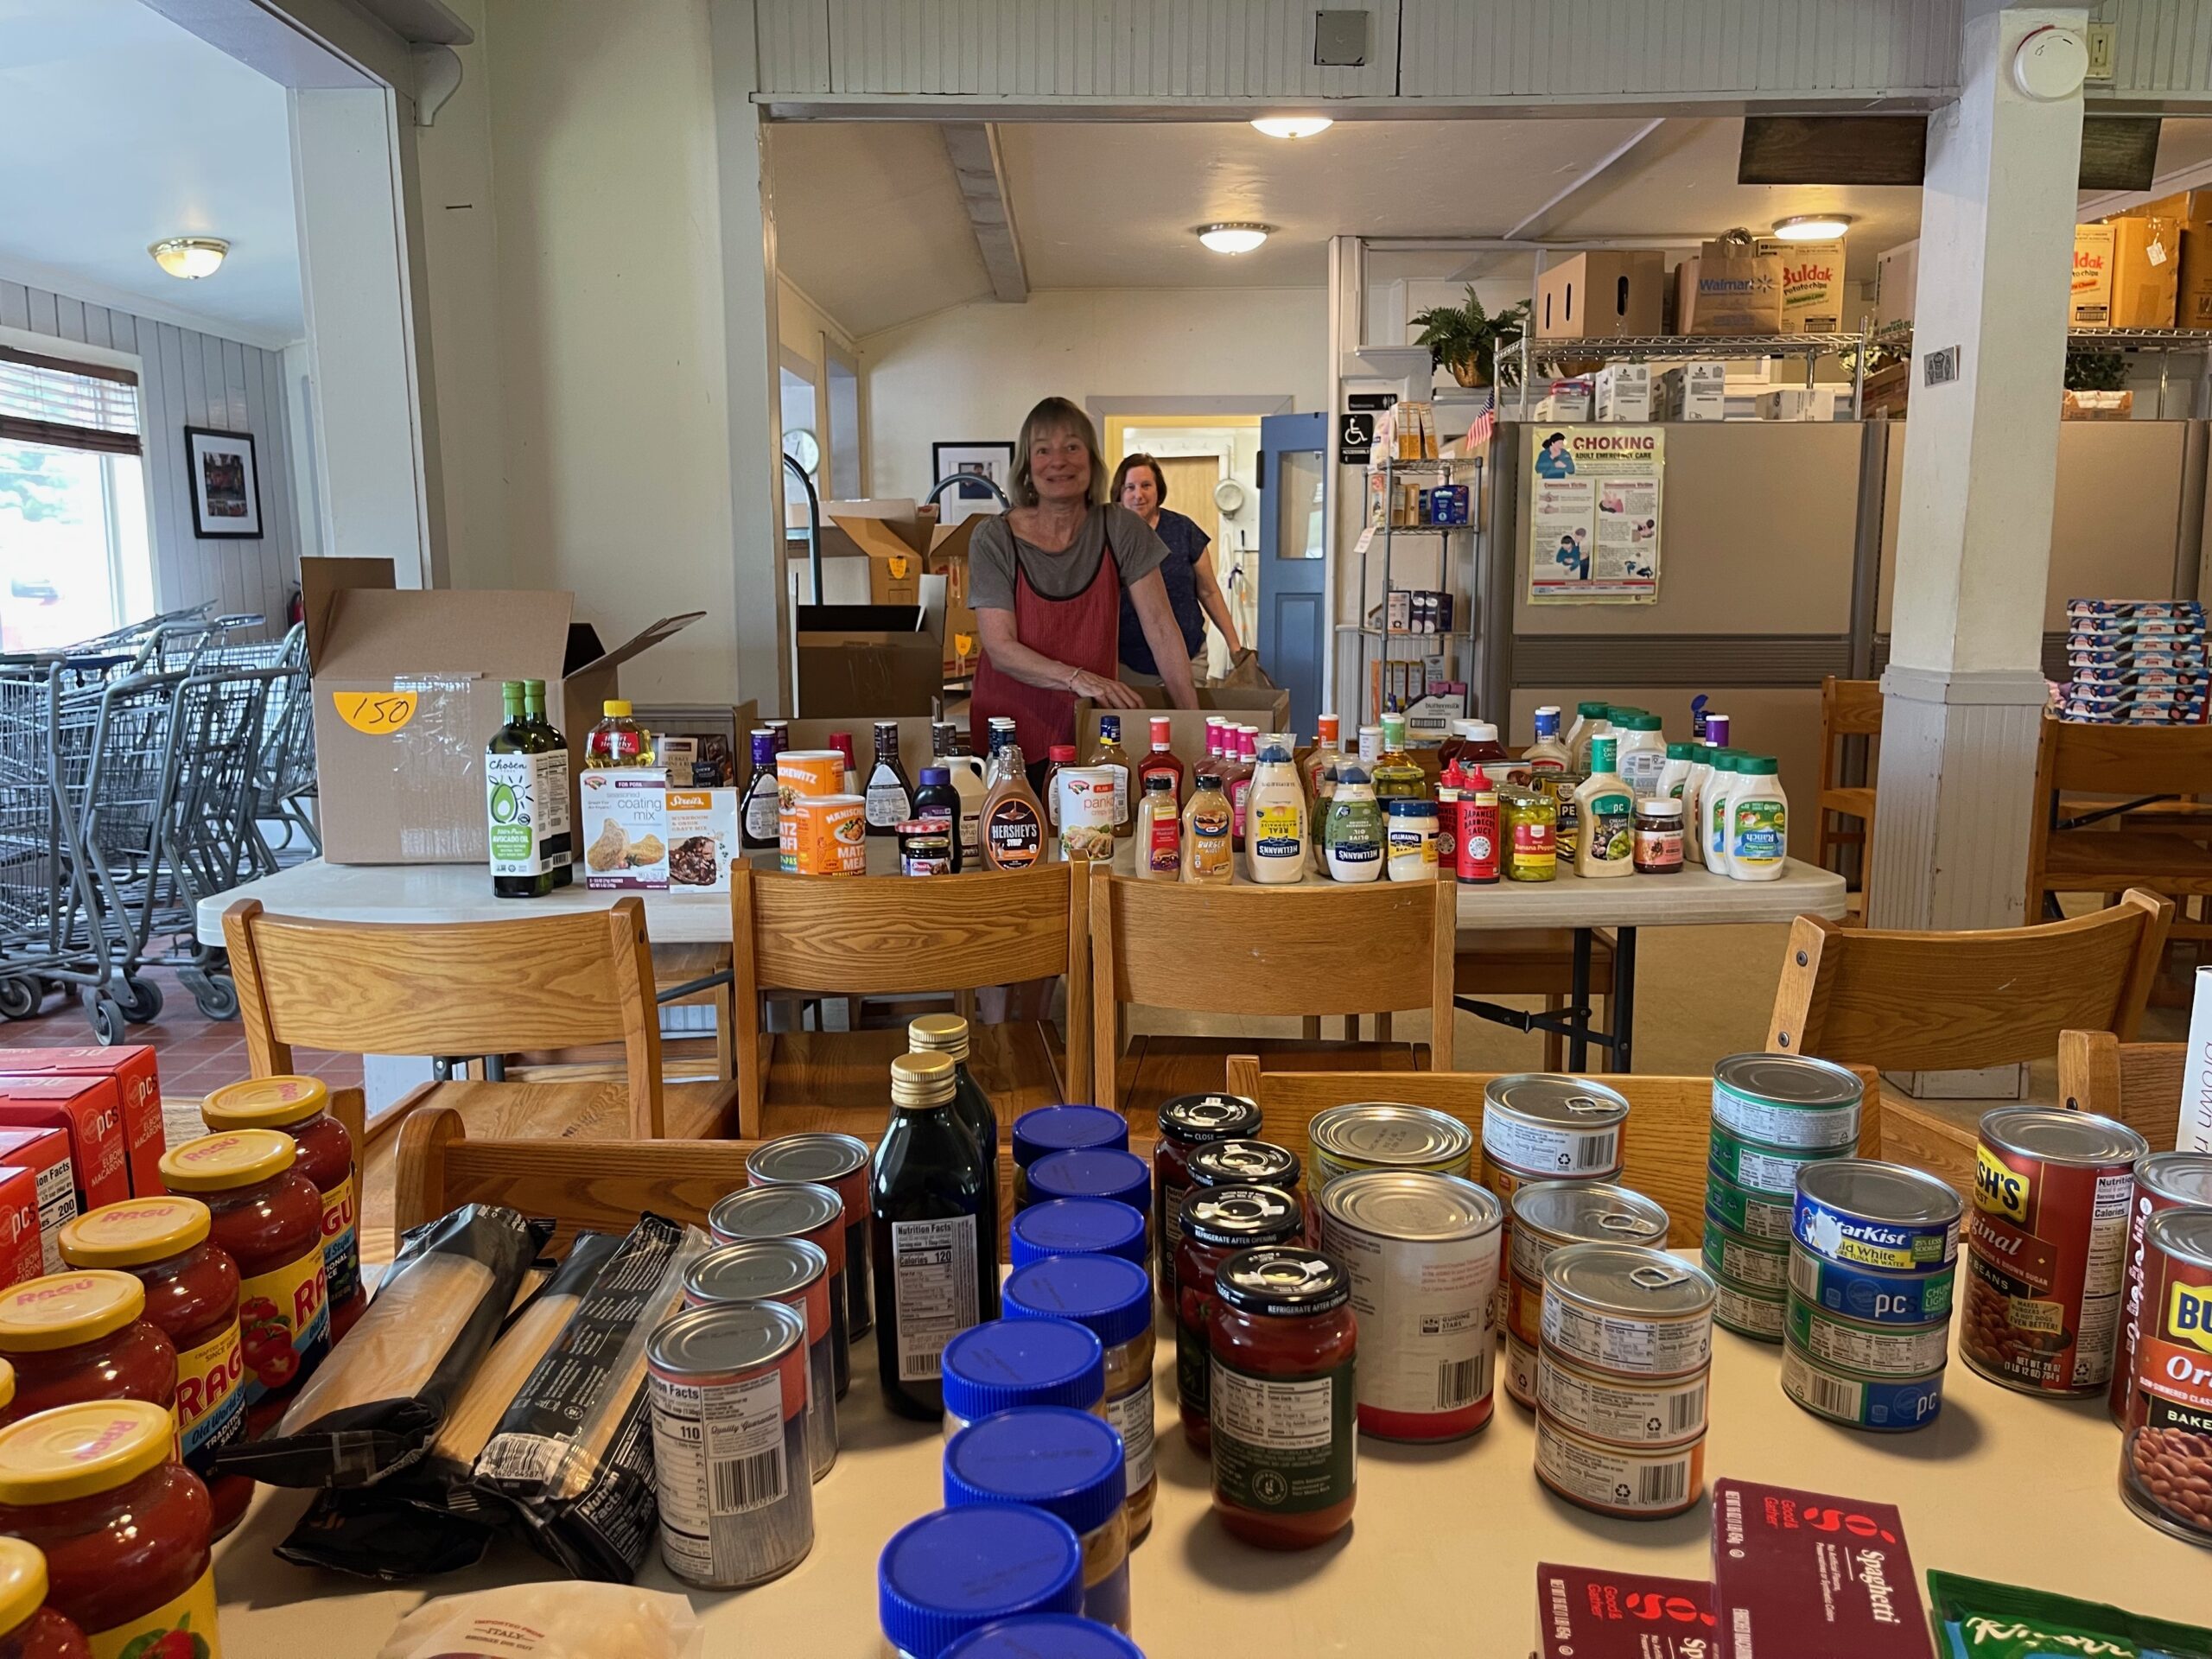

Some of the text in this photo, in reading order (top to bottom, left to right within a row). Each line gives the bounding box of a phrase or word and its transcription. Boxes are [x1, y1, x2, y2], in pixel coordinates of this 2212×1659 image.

[1700, 278, 1754, 291] Walmart
[1573, 436, 1655, 450] CHOKING
[353, 696, 410, 725] 150
[489, 759, 527, 770] Chosen
[617, 798, 662, 811] coating
[633, 810, 656, 821] mix
[1465, 809, 1496, 820] JAPANESE
[992, 824, 1038, 839] HERSHEY'S
[1391, 834, 1419, 842] HELLMANN'S
[1468, 826, 1492, 836] SAUCE
[1746, 833, 1774, 842] Ranch
[1259, 845, 1298, 855] HELLMANN'S
[1338, 849, 1377, 860] HELLMANN'S
[143, 1114, 162, 1132] ELBOW
[1195, 1132, 1215, 1141] CLOSE
[102, 1148, 124, 1168] ELBOW
[50, 1162, 70, 1180] Facts
[91, 1157, 125, 1187] MACARONI
[58, 1199, 75, 1217] 200
[2094, 1207, 2125, 1218] Calories
[898, 1223, 951, 1236] Nutrition Facts
[1194, 1229, 1230, 1243] REFRIGERATE
[1251, 1234, 1277, 1244] OPENING
[899, 1250, 951, 1266] Calories 120
[1851, 1253, 1869, 1263] TUNA
[1858, 1246, 1896, 1262] White
[17, 1250, 41, 1274] ELBOW
[1974, 1260, 2009, 1291] BEANS
[2024, 1271, 2048, 1287] SUGAR
[1268, 1300, 1330, 1313] REFRIGERATE AFTER
[2010, 1316, 2058, 1331] EVEN BETTER!
[2017, 1356, 2028, 1368] NET
[2166, 1356, 2212, 1386] Or
[669, 1383, 700, 1400] Facts
[711, 1412, 778, 1435] Quality Guarantee
[192, 1425, 210, 1446] Old
[220, 1417, 242, 1447] SAUCE
[680, 1426, 701, 1440] 110
[1764, 1497, 1779, 1529] Gather
[1856, 1548, 1902, 1624] Spaghetti
[486, 1627, 524, 1640] ITALY
